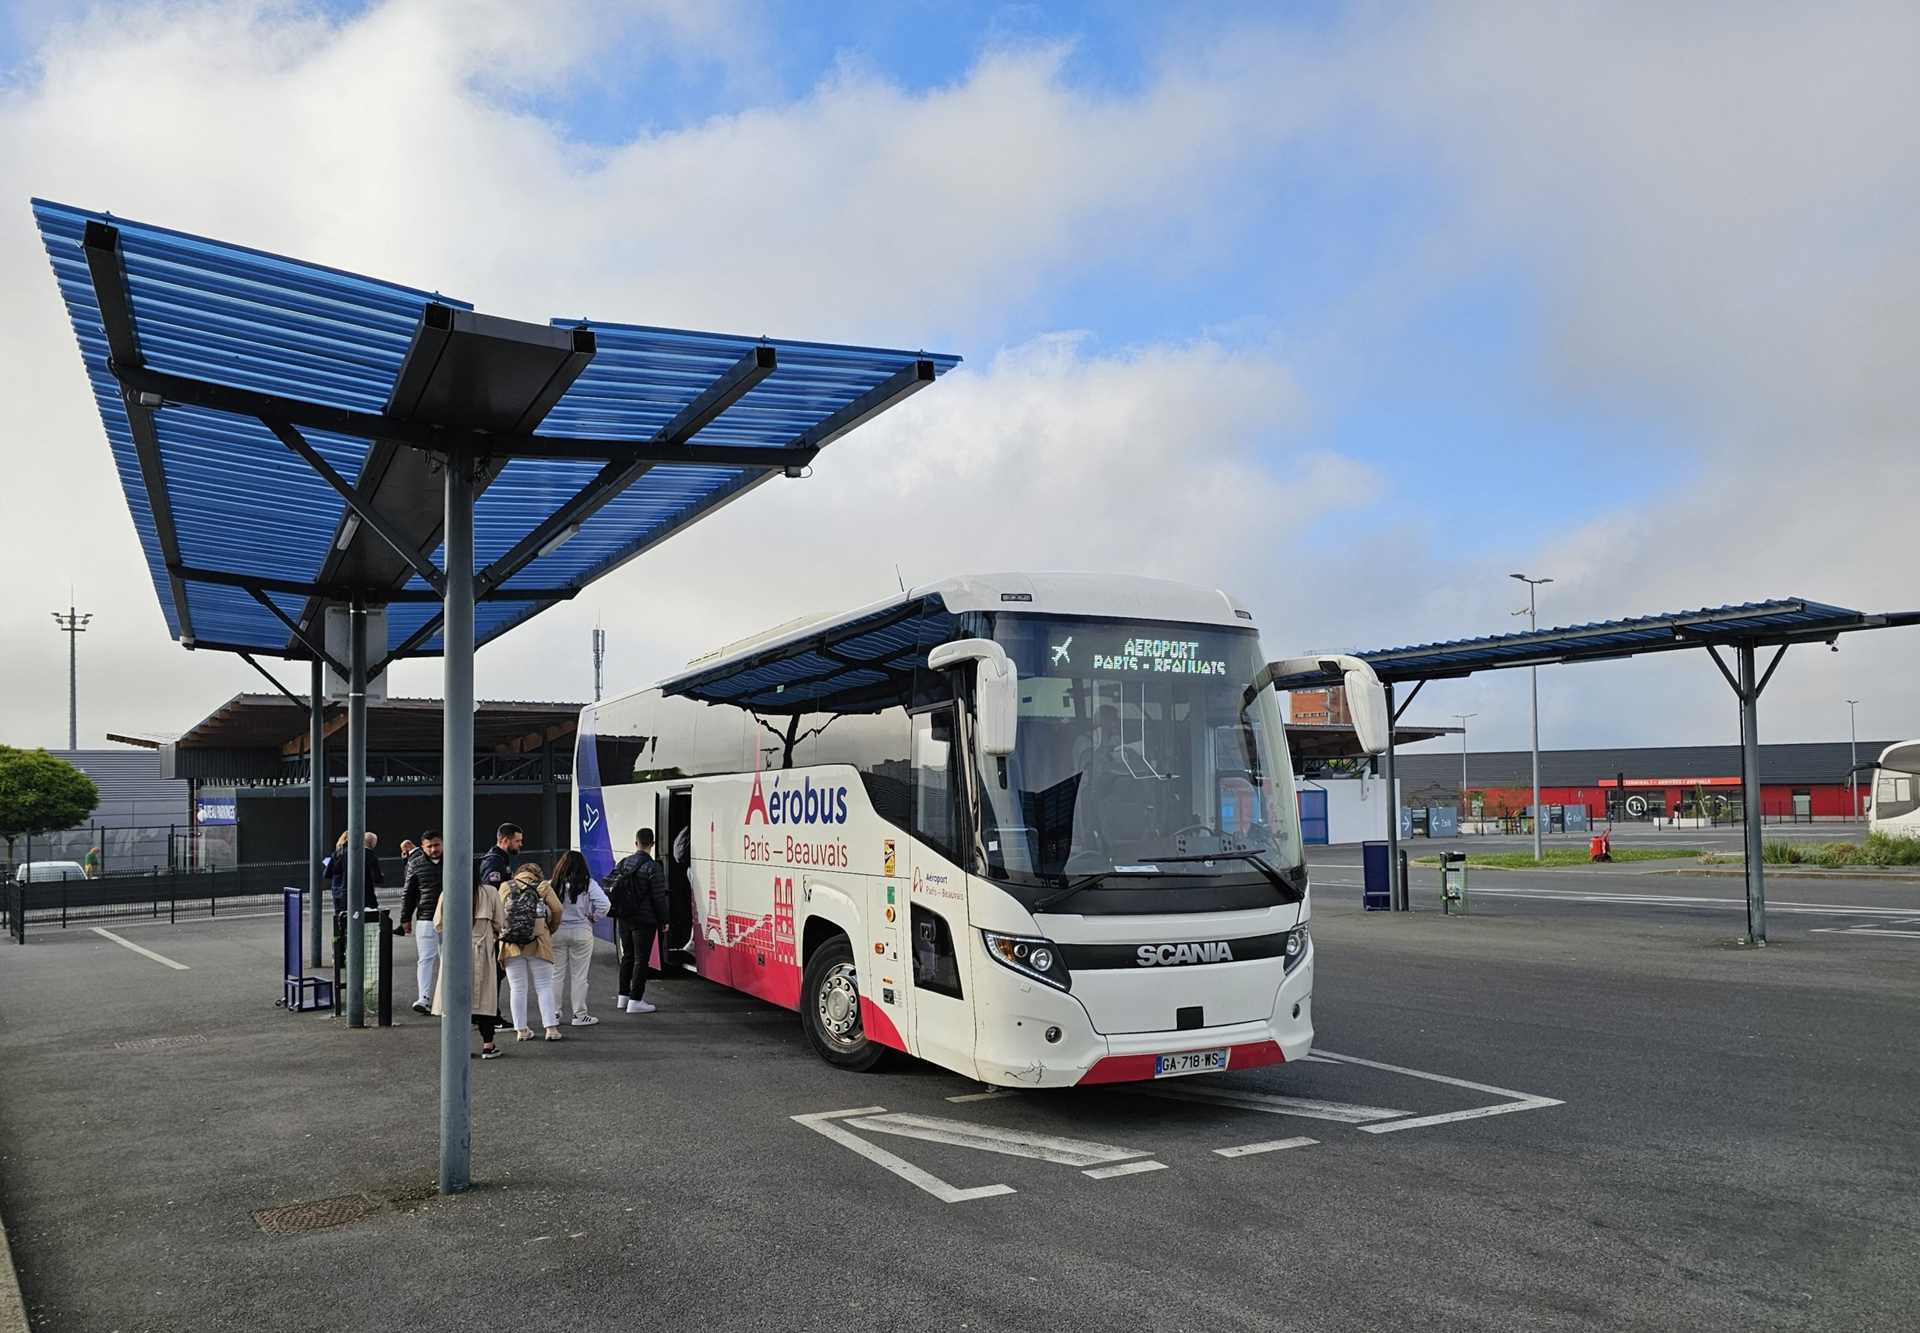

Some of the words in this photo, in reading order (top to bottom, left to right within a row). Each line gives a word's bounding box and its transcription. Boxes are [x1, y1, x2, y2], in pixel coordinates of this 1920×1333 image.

[744, 772, 848, 825] Aérobus
[744, 834, 770, 862] Paris
[786, 834, 848, 868] Beauvais
[1136, 942, 1233, 966] SCANIA
[1162, 1052, 1219, 1071] GA-718-WS
